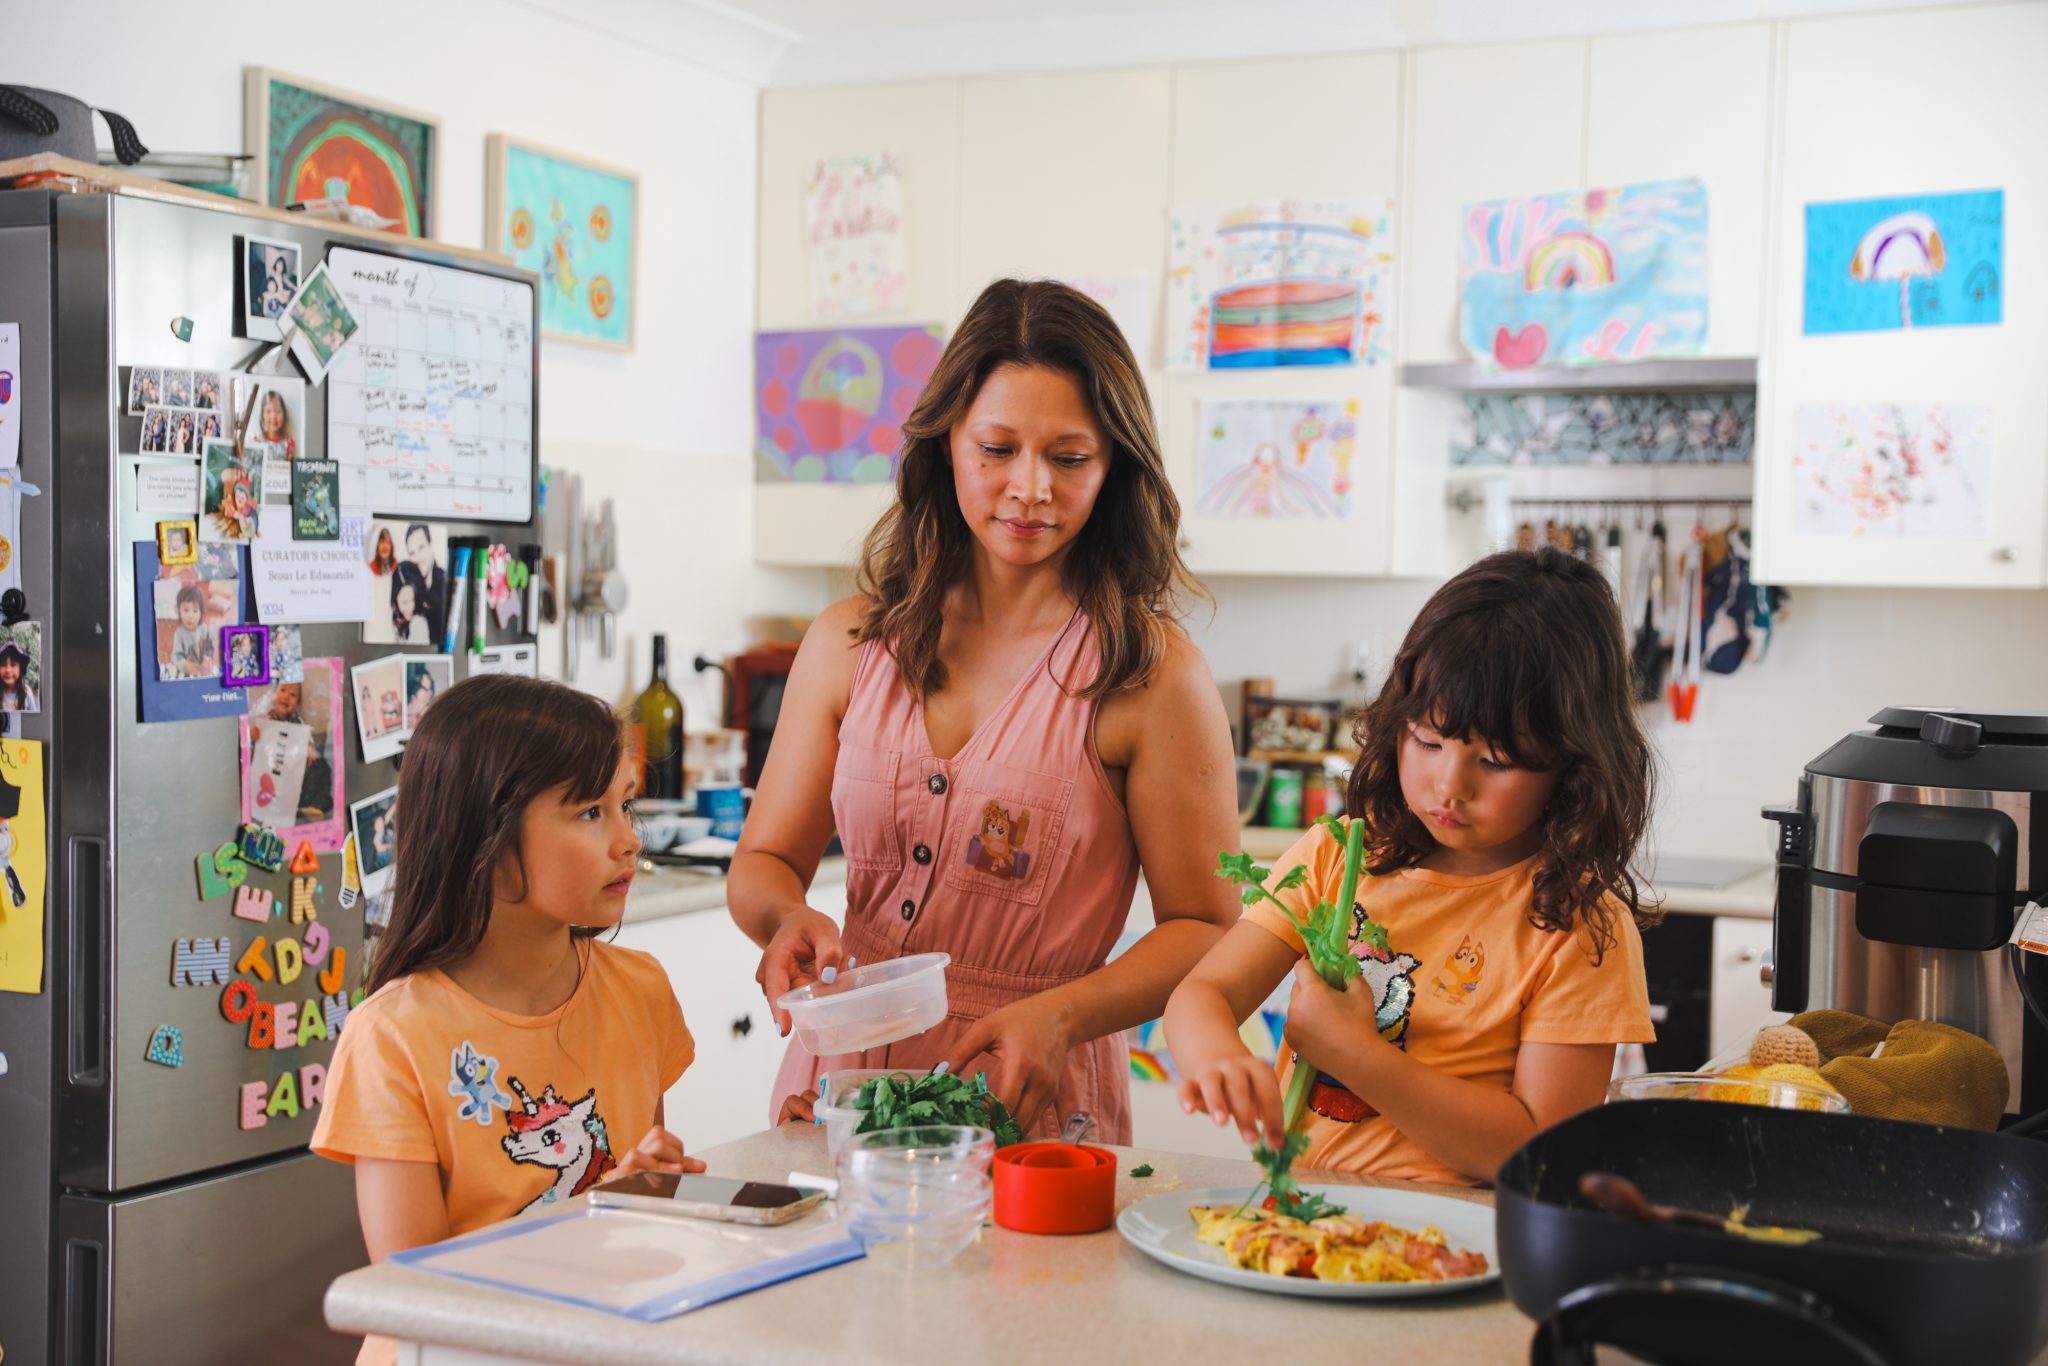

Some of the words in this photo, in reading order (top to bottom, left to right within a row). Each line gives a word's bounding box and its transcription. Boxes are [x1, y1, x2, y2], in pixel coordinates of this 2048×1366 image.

[353, 268, 399, 286] month
[404, 273, 419, 297] of
[262, 551, 318, 561] CURATOR'S
[320, 551, 360, 560] CHOICE
[268, 570, 293, 581] Scout
[263, 602, 285, 615] 2024
